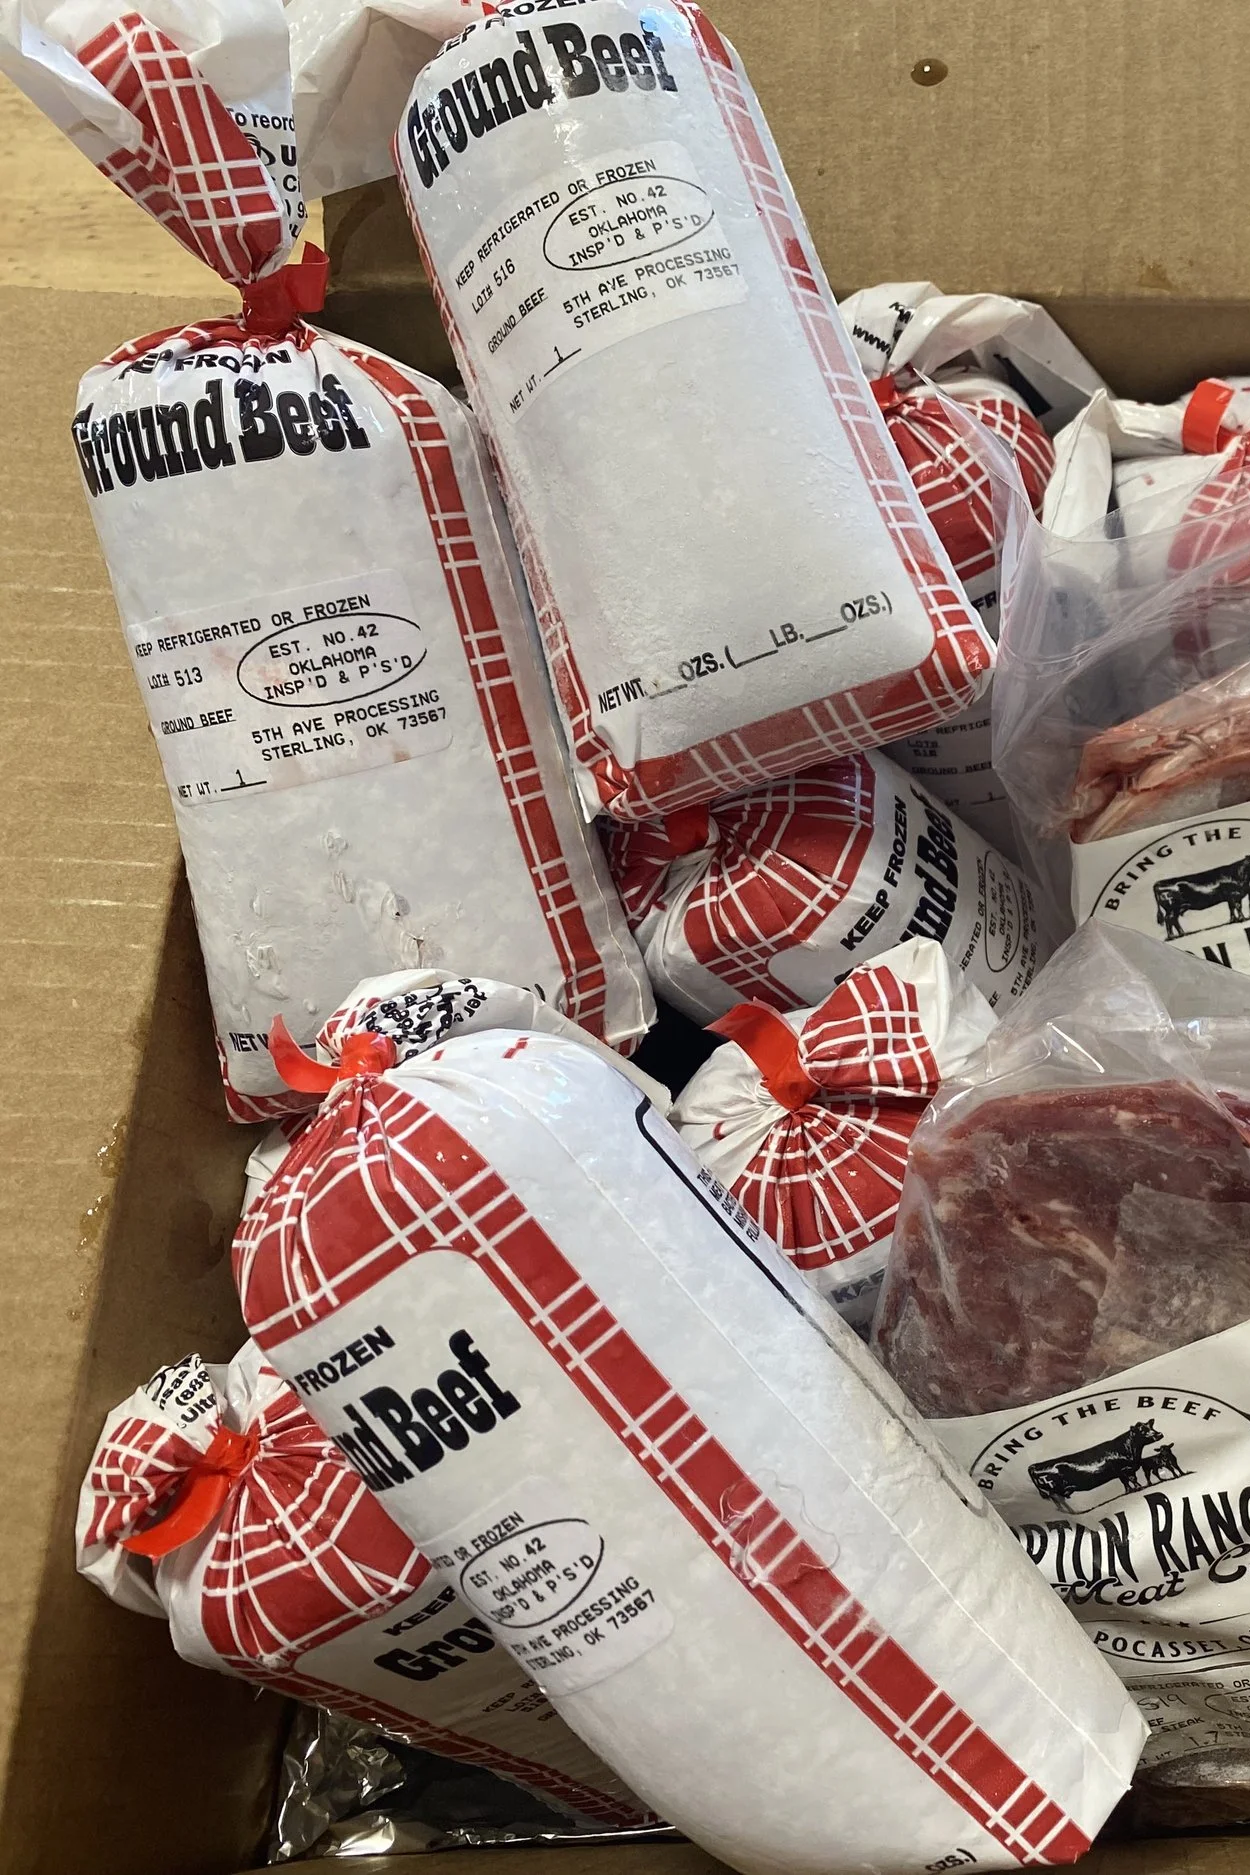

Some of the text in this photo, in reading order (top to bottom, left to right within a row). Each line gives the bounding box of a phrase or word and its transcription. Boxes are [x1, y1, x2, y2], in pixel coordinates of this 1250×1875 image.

[407, 20, 678, 189] Ground Beef
[455, 160, 657, 290] KEEP REFRIGERATED OR FROZEN
[569, 205, 606, 226] EST.
[569, 214, 702, 267] INSP'D & P'S'D
[588, 205, 668, 238] OKLAHOMA
[471, 258, 515, 314] LOT# 516
[563, 247, 732, 314] 5TH AVE PROCESSING
[573, 264, 740, 329] STERLING, OK 73567
[487, 287, 546, 354] GROUND BEEF
[509, 389, 525, 413] NET
[525, 374, 542, 394] WT.
[71, 374, 371, 498] Ground Beef
[135, 594, 371, 658] KEEP REFRIGERATED OR FROZEN
[269, 640, 311, 659] EST.
[147, 667, 203, 690] LOT# 513
[264, 655, 413, 700] INSP'D & P'S'D
[289, 646, 377, 676] OKLAHOMA
[598, 682, 623, 714] NET
[621, 677, 648, 703] WT.
[677, 652, 725, 682] OZS.
[160, 708, 234, 735] GROUND BEEF
[251, 689, 440, 744] 5TH AVE PROCESSING
[261, 706, 447, 762] STERLING, OK 73567
[177, 785, 192, 798] NET
[197, 781, 218, 795] WT.
[840, 795, 907, 951] KEEP FROZEN
[1105, 845, 1173, 911] BRING
[1183, 827, 1242, 846] THE
[229, 1032, 258, 1052] NET
[294, 1325, 396, 1396] FROZEN
[360, 1329, 521, 1473] Beef
[978, 1395, 1222, 1490] BRING THE BEEF
[454, 1511, 525, 1561] OR FROZEN
[469, 1570, 499, 1589] EST.
[492, 1559, 556, 1602] OKLAHOMA
[532, 1590, 546, 1602] &
[546, 1555, 594, 1593] P'S'D
[382, 1585, 457, 1637] KEEP
[551, 1576, 640, 1641] PROCESSING
[583, 1627, 606, 1646] OK
[606, 1588, 656, 1630] 73567
[1233, 1679, 1250, 1689] OR
[1160, 1717, 1205, 1732] STEAK
